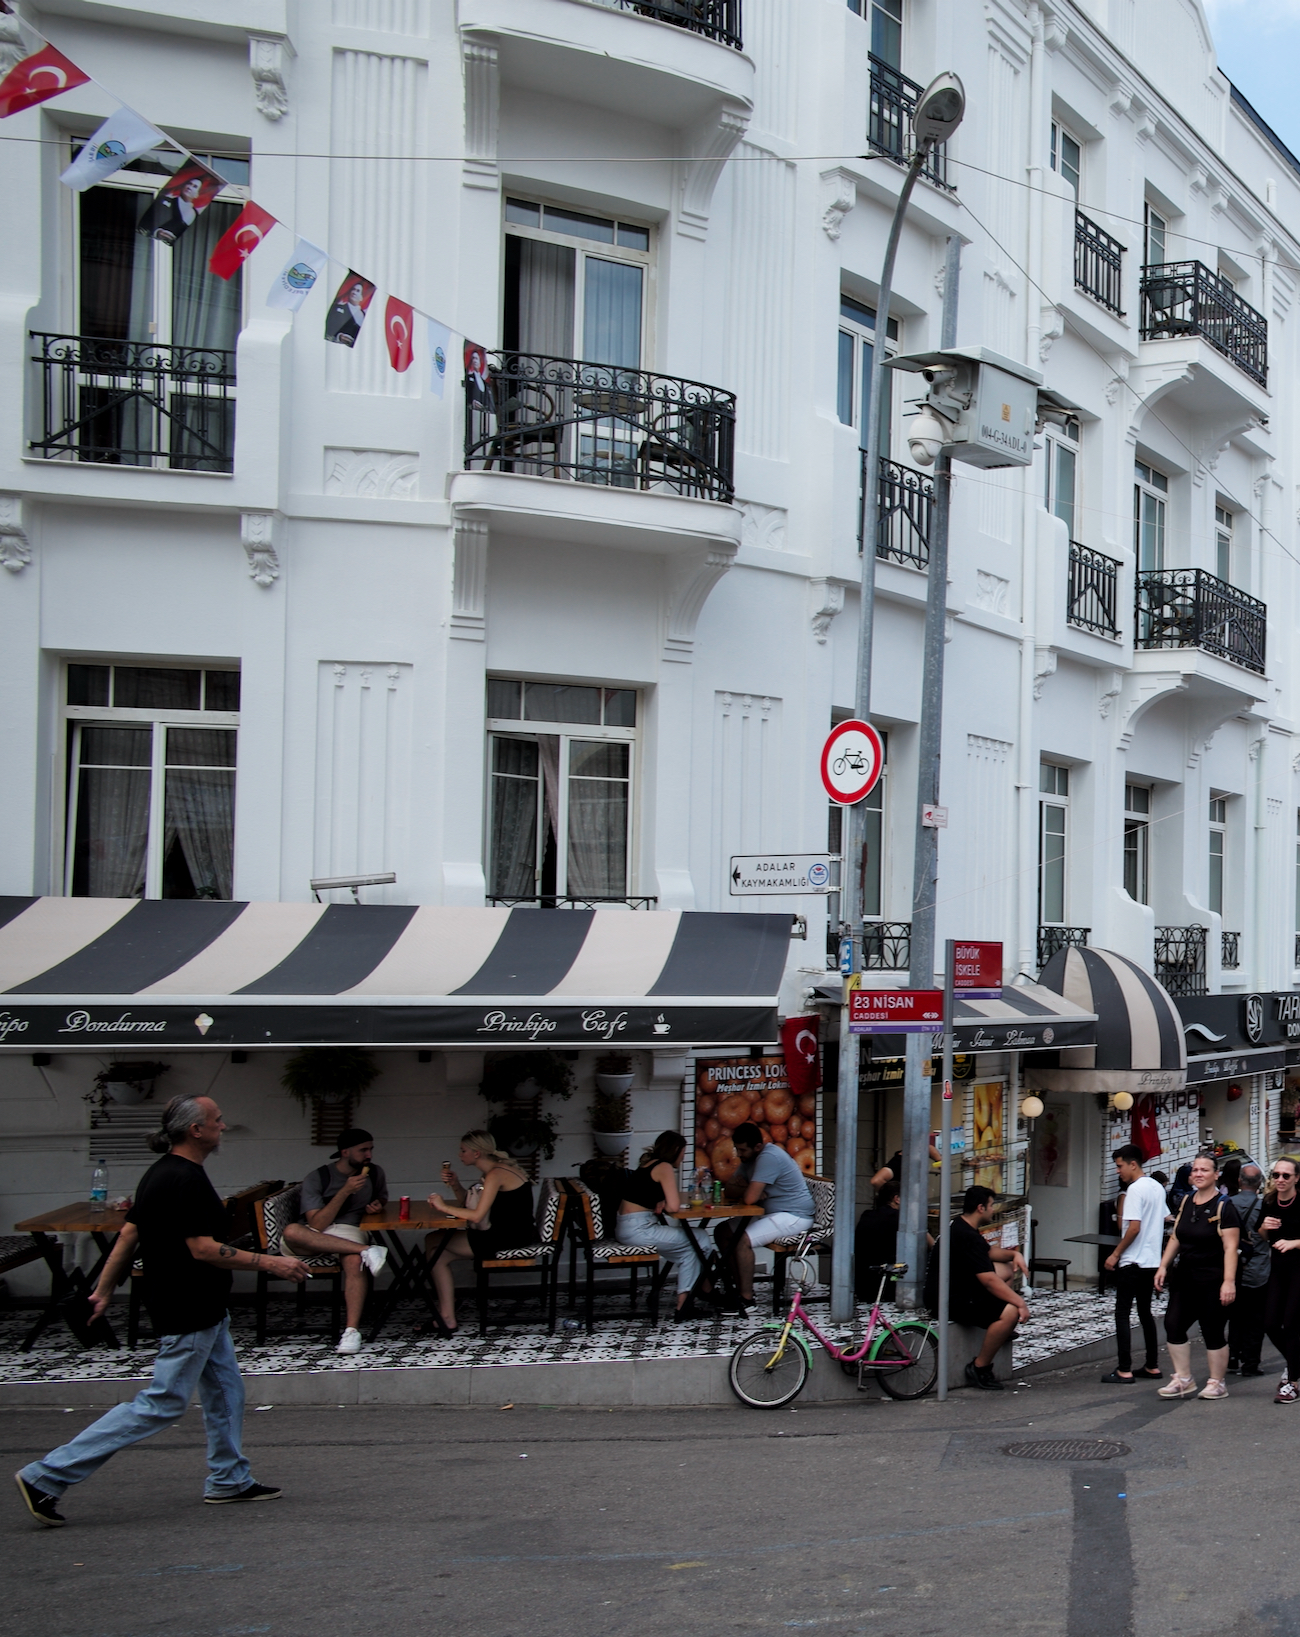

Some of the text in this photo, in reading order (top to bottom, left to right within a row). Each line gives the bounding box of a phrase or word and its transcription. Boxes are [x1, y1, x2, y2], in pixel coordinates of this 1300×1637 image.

[756, 862, 796, 871] ADALAR
[741, 877, 810, 888] KAYMAKAMLIĞI
[955, 945, 980, 960] BÜYÜK
[955, 963, 981, 976] İSKELE
[853, 994, 914, 1009] 23 NİSAN
[58, 1010, 168, 1033] Dondurma
[853, 1011, 889, 1020] CADDESİ
[476, 1010, 628, 1040] Prinkipo Cafe
[969, 1028, 995, 1048] İzmir
[707, 1064, 788, 1081] PRINCESS LOK
[859, 1069, 881, 1086] eşhur
[882, 1066, 905, 1081] İzmir
[716, 1083, 745, 1094] Meşhur
[746, 1081, 766, 1091] İzmir
